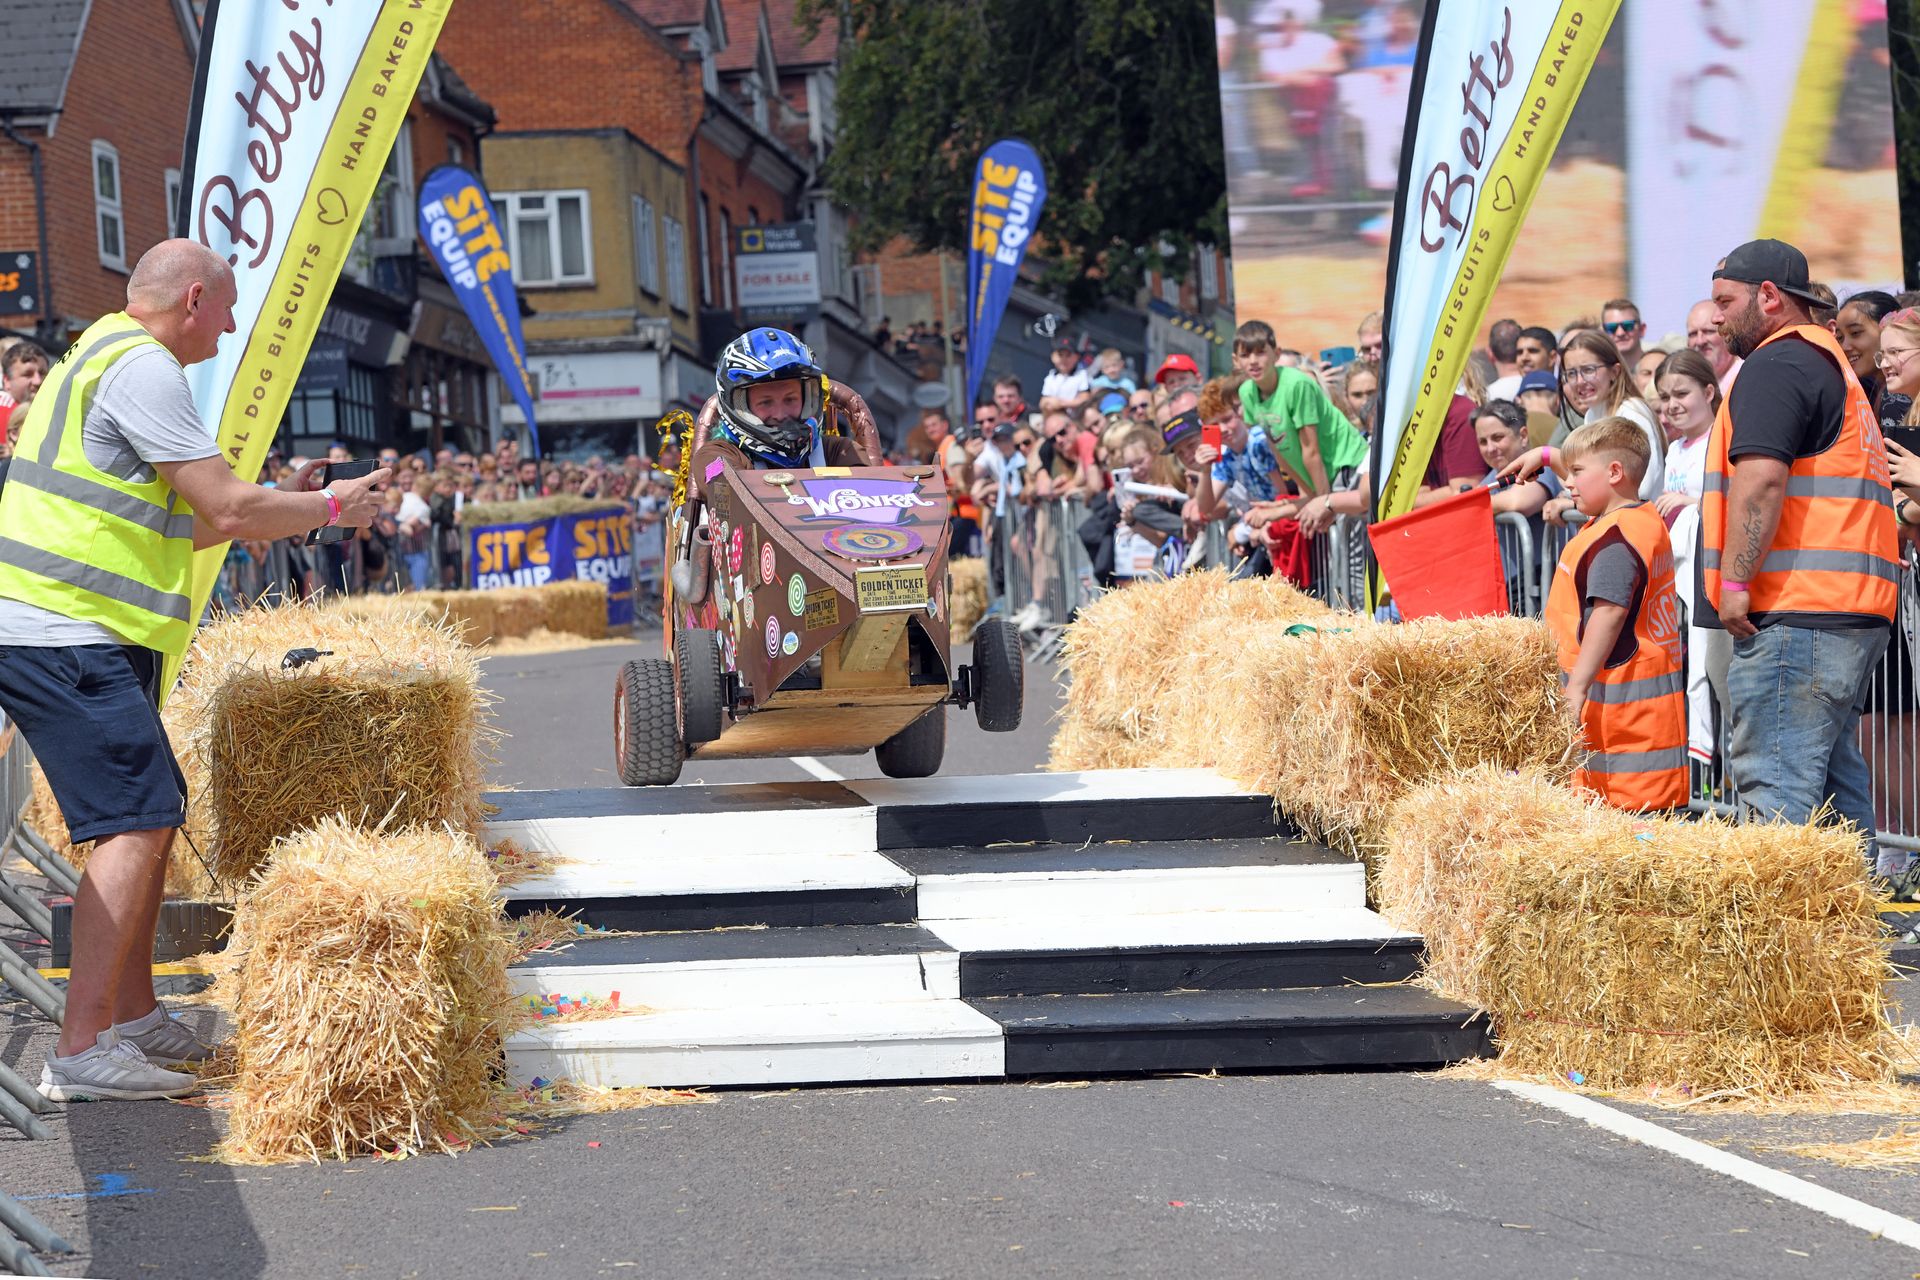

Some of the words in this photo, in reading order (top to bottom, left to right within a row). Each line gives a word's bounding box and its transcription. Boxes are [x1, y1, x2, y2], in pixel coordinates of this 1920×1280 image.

[245, 368, 273, 419] DOG
[268, 243, 321, 357] BISCUITS
[341, 106, 377, 171] HAND
[372, 20, 414, 98] BAKED
[422, 200, 477, 290] EQUIP
[996, 170, 1037, 266] EQUIP
[1423, 349, 1444, 397] DOG
[1443, 228, 1490, 338] BISCUITS
[1515, 96, 1546, 158] HAND
[1545, 12, 1583, 87] BAKED
[743, 273, 771, 287] FOR
[776, 271, 811, 286] SALE
[861, 580, 893, 592] GOLDEN
[895, 578, 924, 590] TICKET
[1734, 511, 1762, 578] Royston
